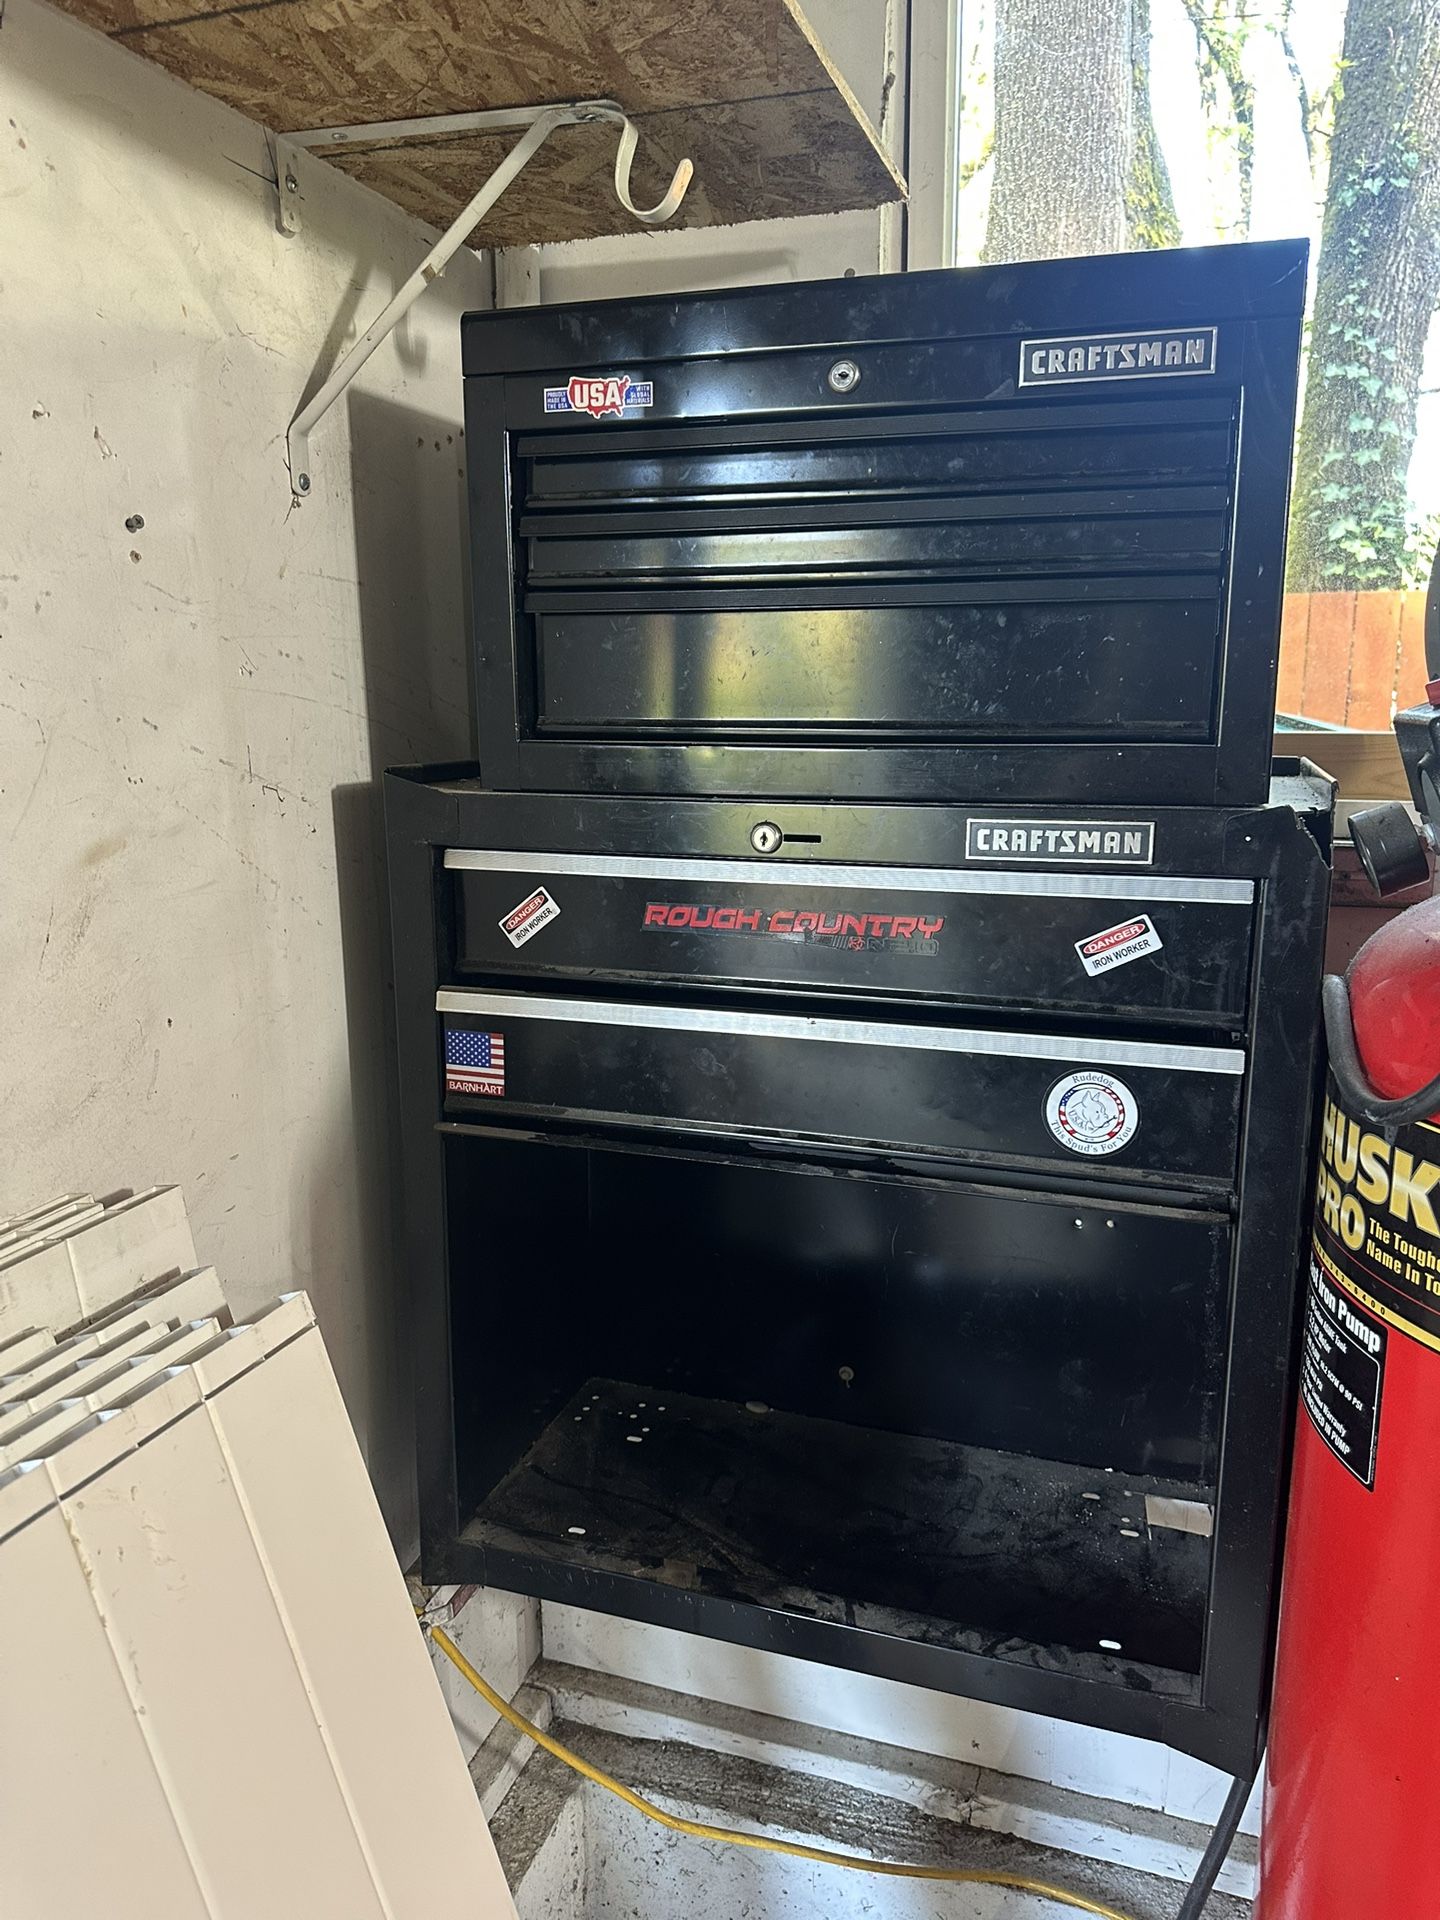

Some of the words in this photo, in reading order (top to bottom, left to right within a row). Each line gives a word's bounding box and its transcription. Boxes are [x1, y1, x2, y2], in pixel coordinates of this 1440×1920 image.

[1031, 338, 1205, 375] CRAFTSMAN
[574, 381, 622, 408] USA
[977, 828, 1142, 855] CRAFTSMAN
[509, 897, 542, 928] DANGER
[515, 926, 530, 941] IRON
[528, 907, 553, 930] WORKER
[644, 904, 763, 930] ROUGH
[768, 910, 944, 939] COUNTRY
[1088, 925, 1141, 953] DANGER
[1092, 954, 1114, 969] IRON
[1113, 939, 1151, 960] WORKER
[449, 1080, 503, 1095] BARNHART
[1072, 1072, 1115, 1088] Rudedog
[1050, 1119, 1065, 1140] This
[1065, 1137, 1098, 1152] Spud's
[1101, 1141, 1118, 1152] For
[1116, 1126, 1132, 1143] You
[1316, 1158, 1366, 1251] PRO
[1369, 1217, 1391, 1245] The
[1366, 1238, 1402, 1275] Name
[1405, 1262, 1420, 1286] In
[1338, 1298, 1381, 1354] Pump
[1335, 1334, 1347, 1354] Tank
[1352, 1396, 1363, 1412] PSI
[1323, 1403, 1347, 1438] Warranty
[1331, 1429, 1351, 1455] PUMP
